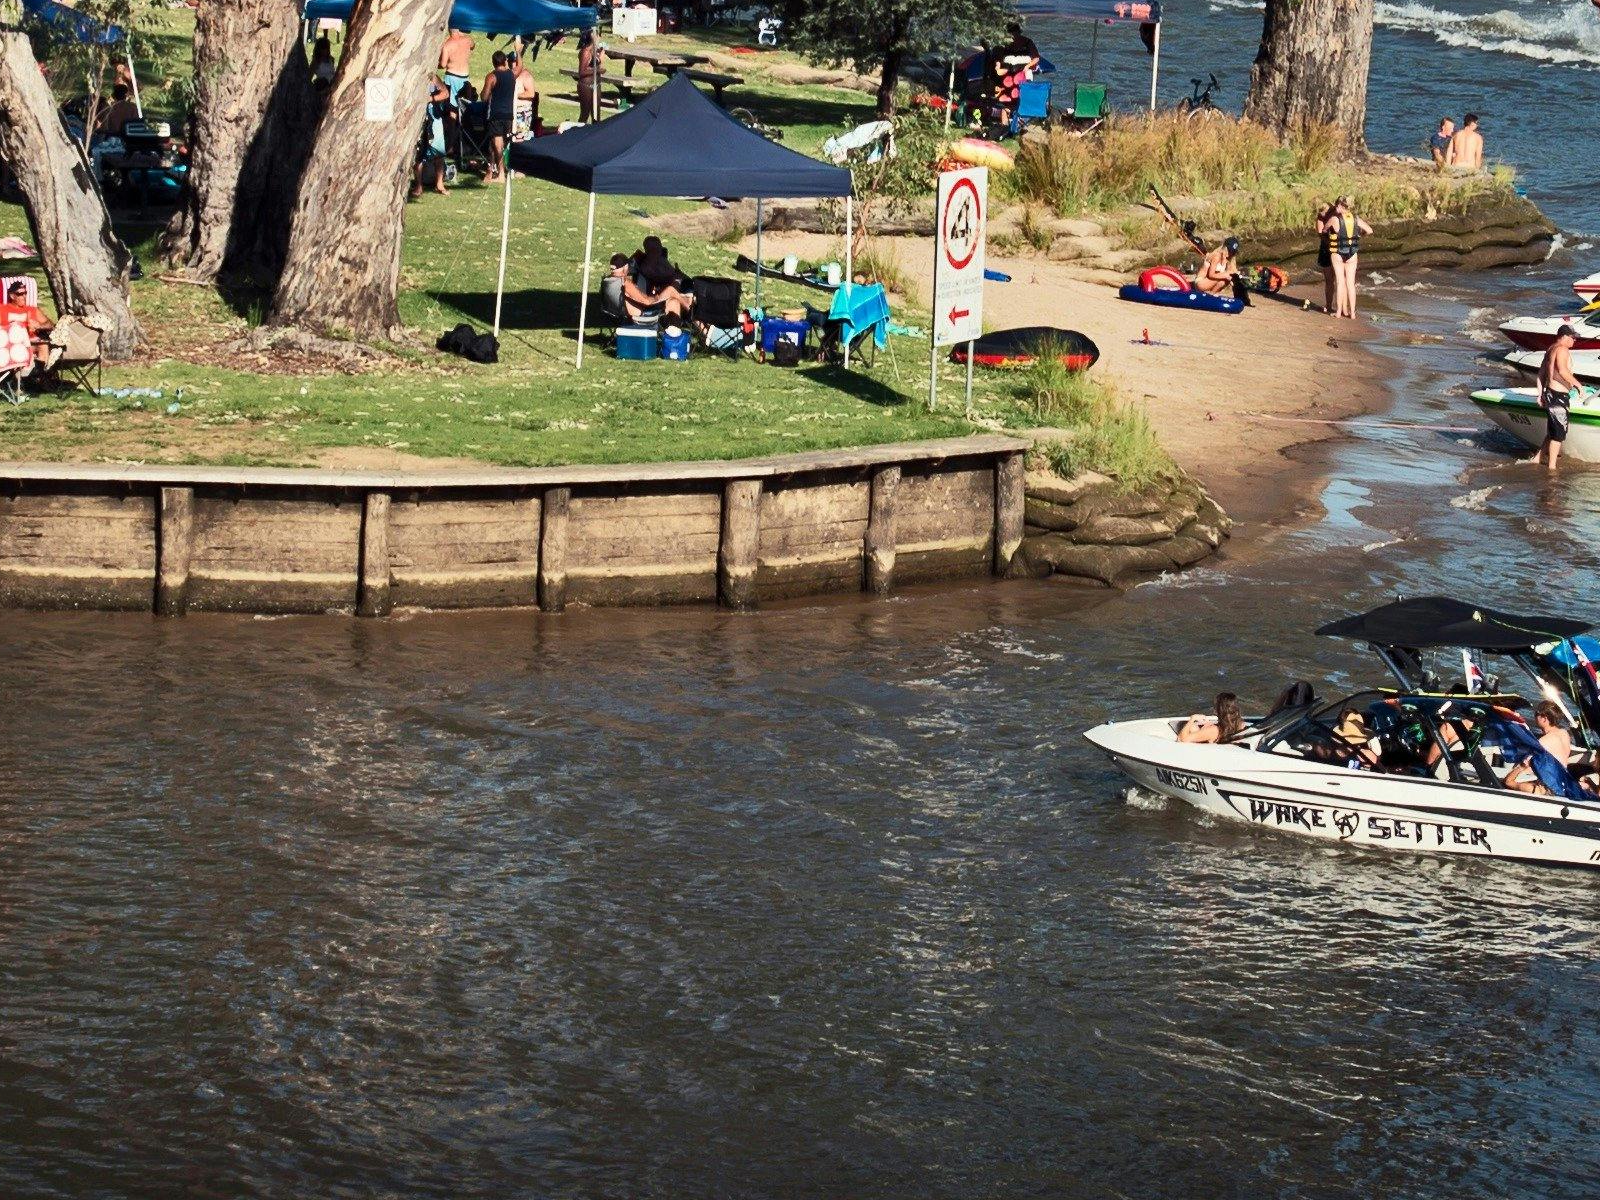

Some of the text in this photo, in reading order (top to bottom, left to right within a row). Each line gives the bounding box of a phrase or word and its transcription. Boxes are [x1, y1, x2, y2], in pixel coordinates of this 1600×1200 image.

[950, 196, 972, 247] 4
[1249, 798, 1492, 853] WAKE SETTER
